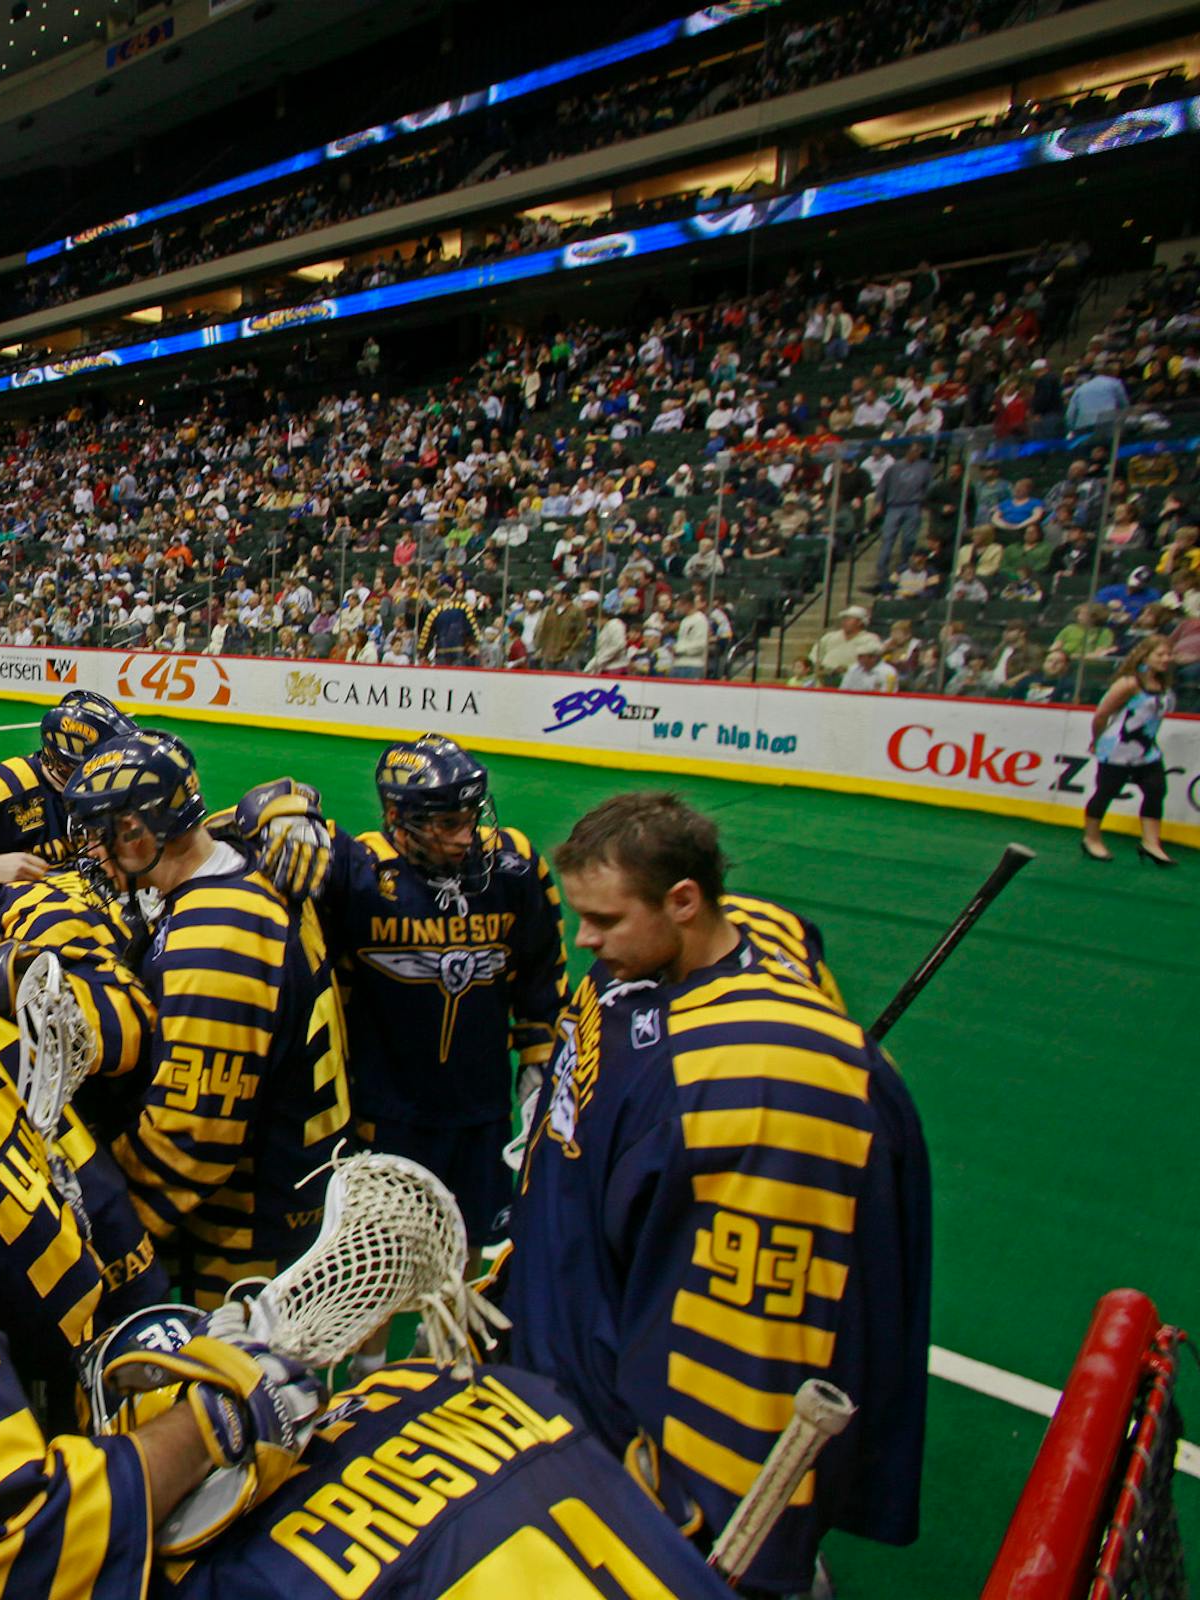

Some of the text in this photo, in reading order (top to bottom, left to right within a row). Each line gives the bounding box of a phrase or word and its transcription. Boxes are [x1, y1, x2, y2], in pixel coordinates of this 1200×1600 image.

[140, 660, 197, 701] 45
[322, 680, 480, 715] CAMBRIA
[887, 724, 1042, 787] Coke
[153, 1044, 245, 1118] 34
[708, 1210, 814, 1318] 93
